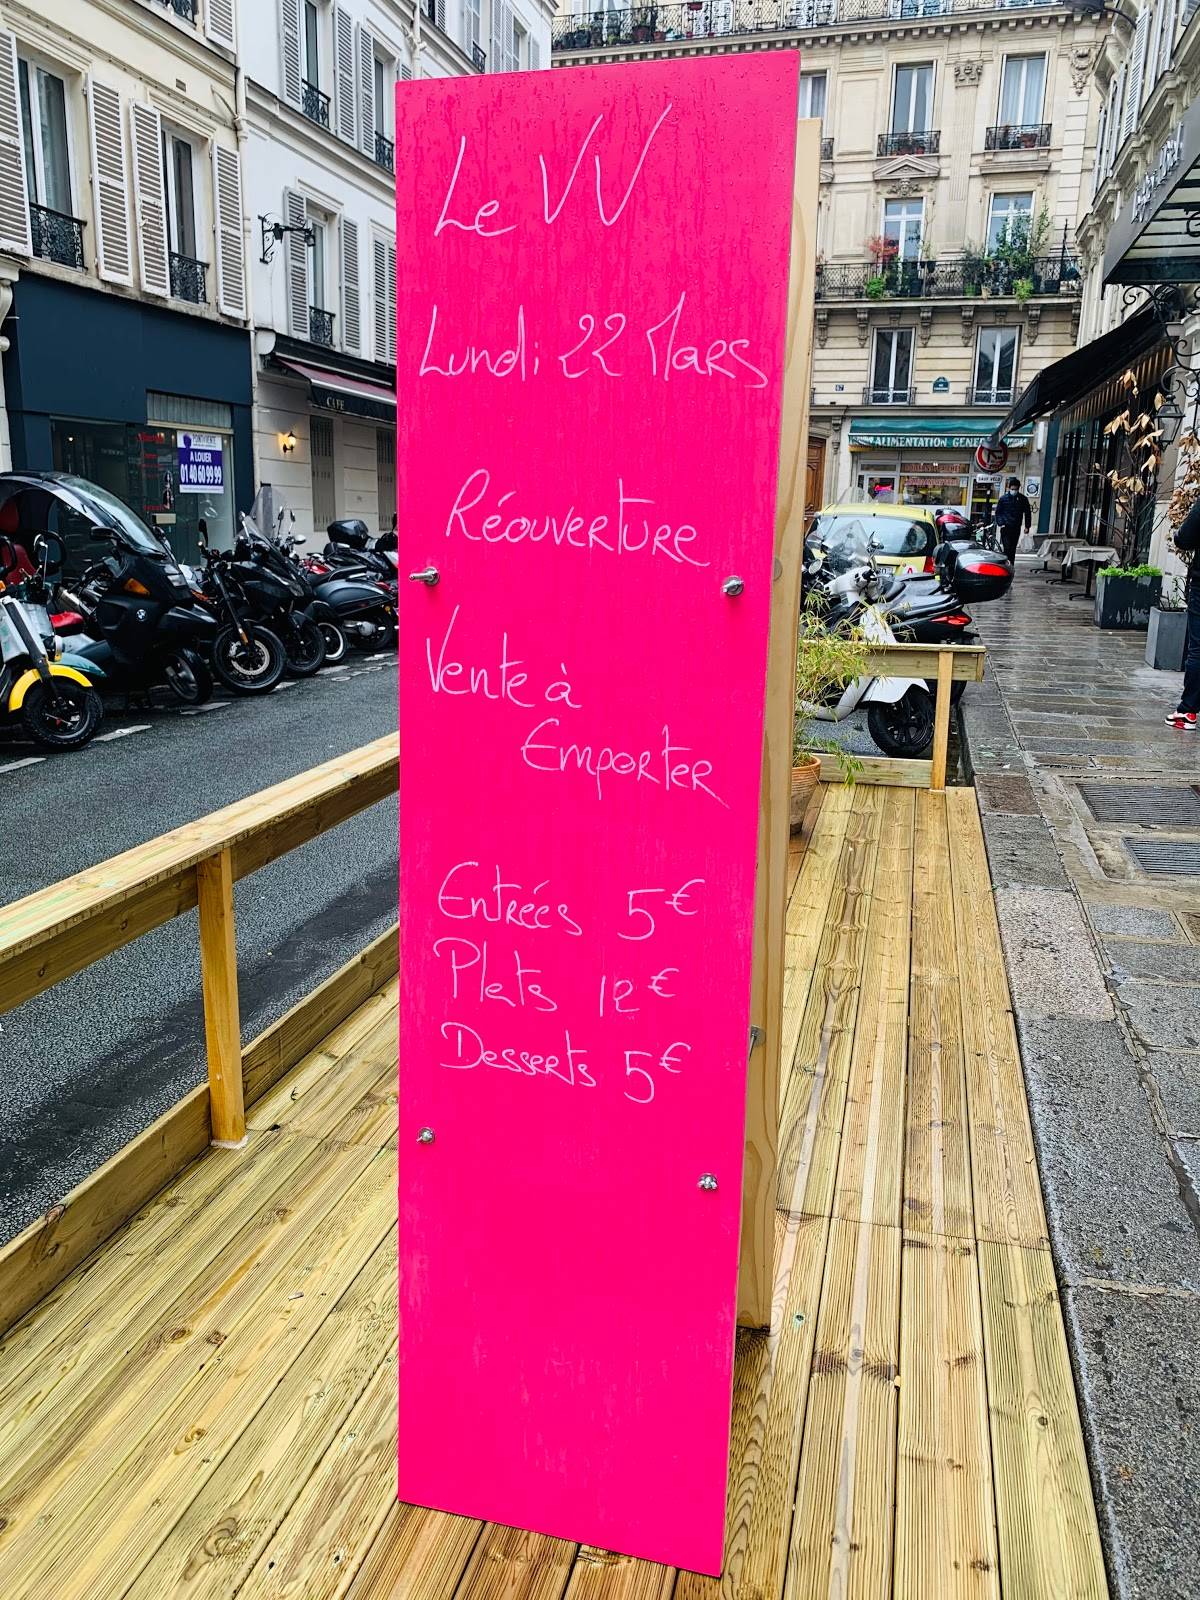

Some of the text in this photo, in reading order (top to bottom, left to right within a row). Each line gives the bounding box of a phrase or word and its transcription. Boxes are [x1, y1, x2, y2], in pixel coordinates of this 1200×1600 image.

[434, 136, 517, 237] Le
[419, 291, 769, 389] Lundi 22 Mars
[181, 464, 222, 485] 01 40 60 99 99
[190, 452, 212, 463] A LOUER
[875, 436, 948, 448] ALIMENTATION
[445, 468, 711, 567] Réouverture
[426, 604, 582, 709] Vente à
[520, 717, 729, 807] Emporter
[437, 861, 583, 937] Entrées
[439, 1021, 597, 1087] Desserts
